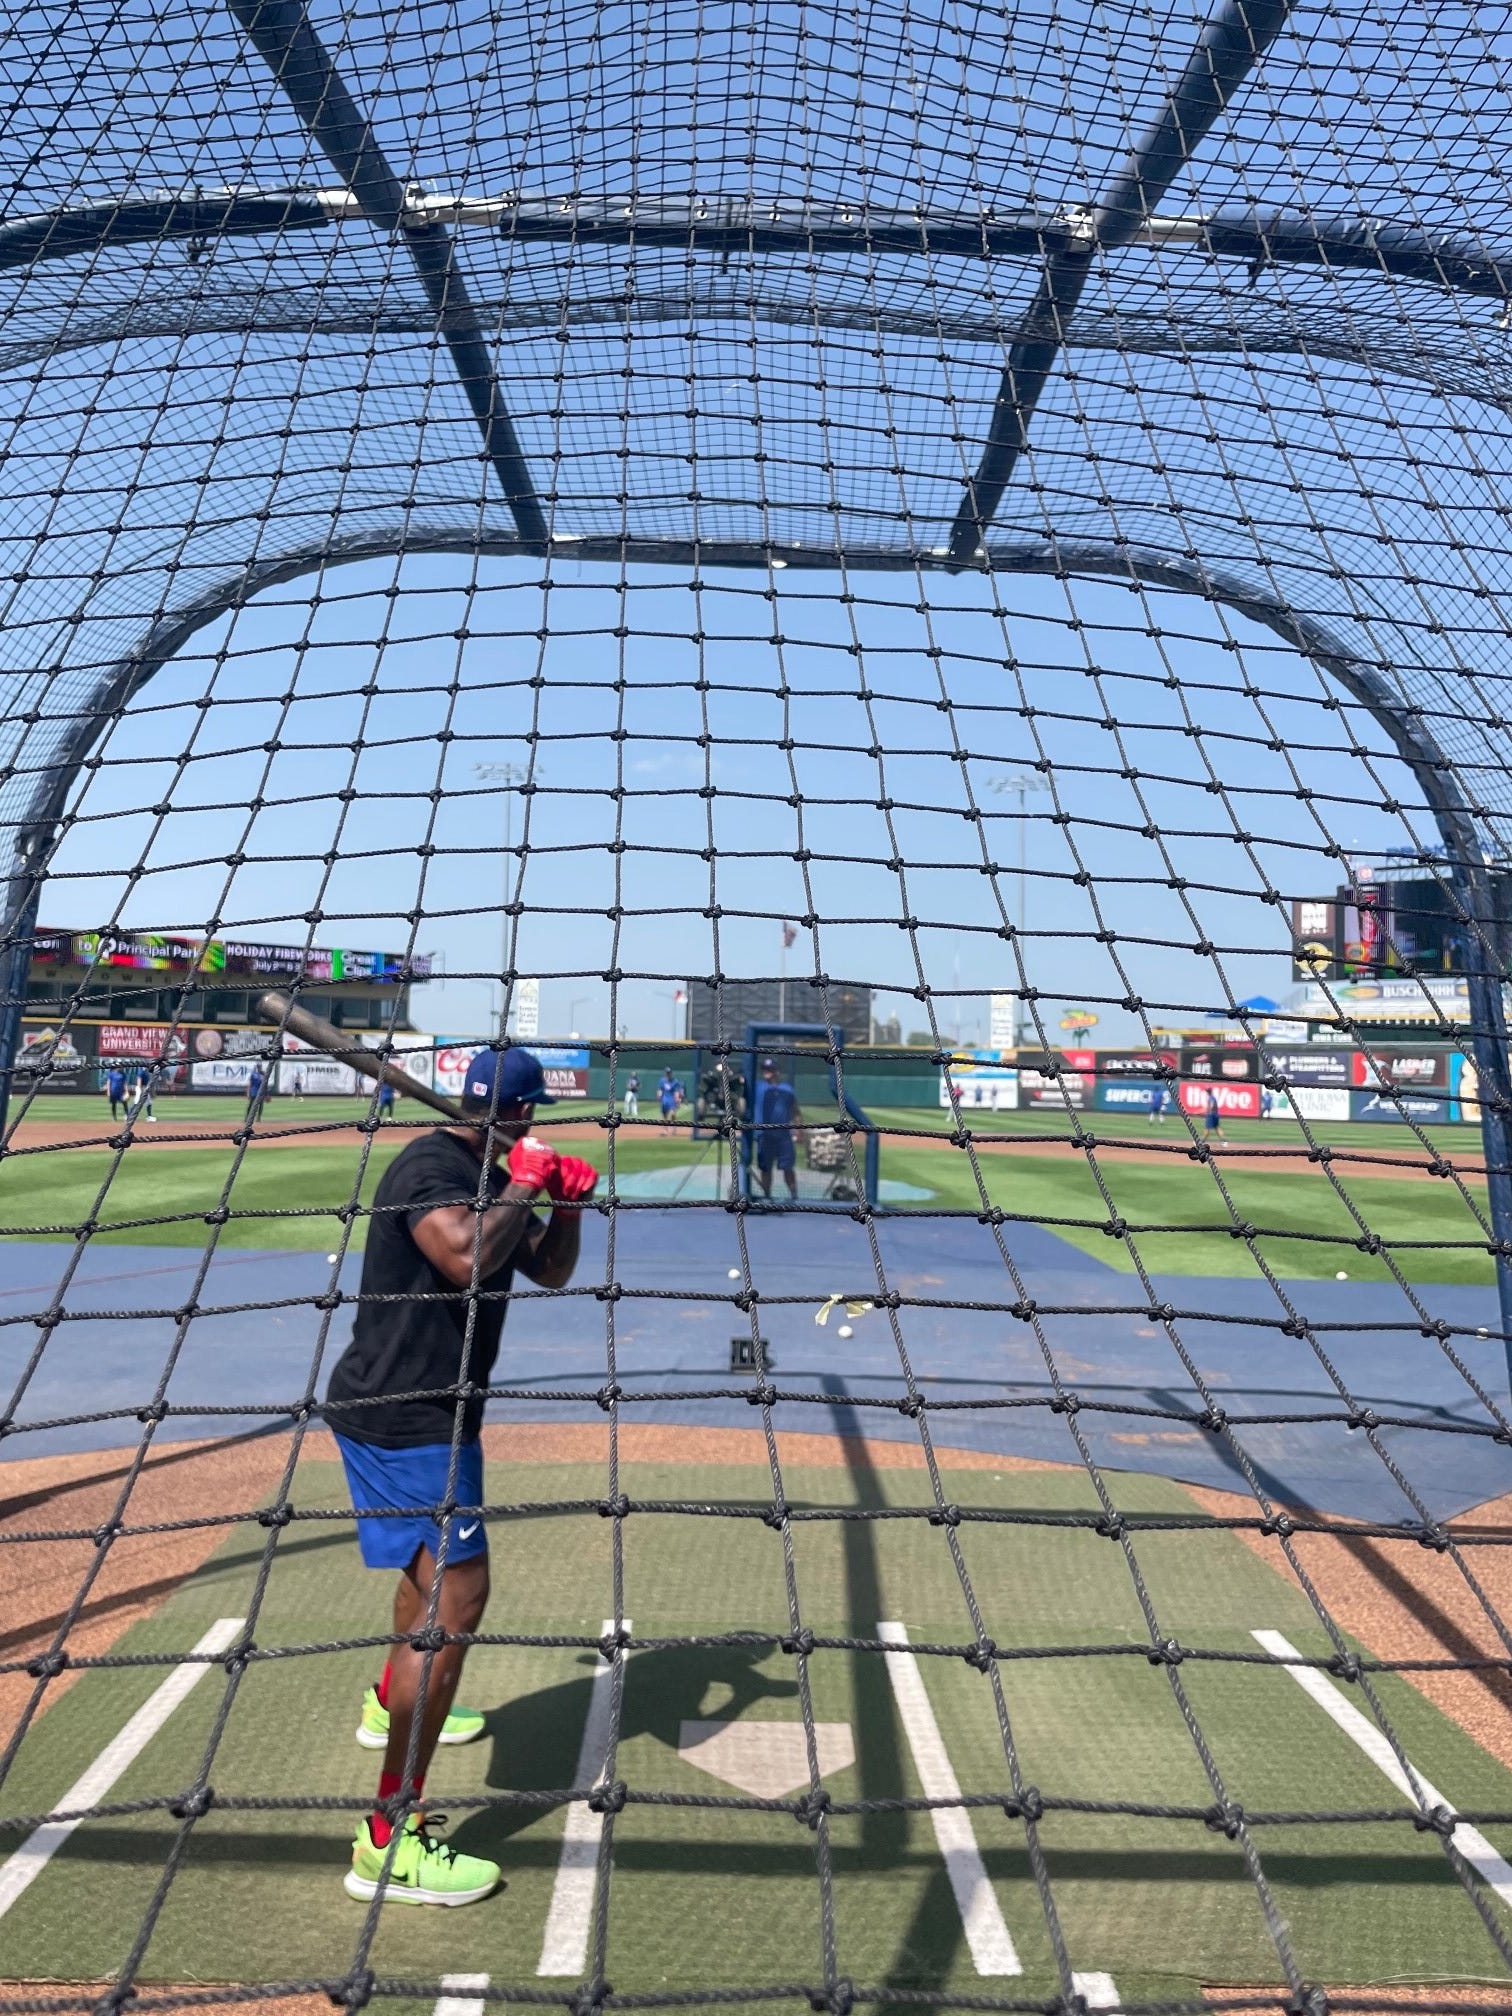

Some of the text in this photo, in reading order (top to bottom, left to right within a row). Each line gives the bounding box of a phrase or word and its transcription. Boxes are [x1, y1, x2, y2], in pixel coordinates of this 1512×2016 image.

[118, 941, 201, 958] Principal Park
[227, 944, 333, 962] HOLIDAY FIREWORKS
[102, 1026, 169, 1039] GRAND VIEW
[102, 1038, 164, 1050] UNIVERSITY
